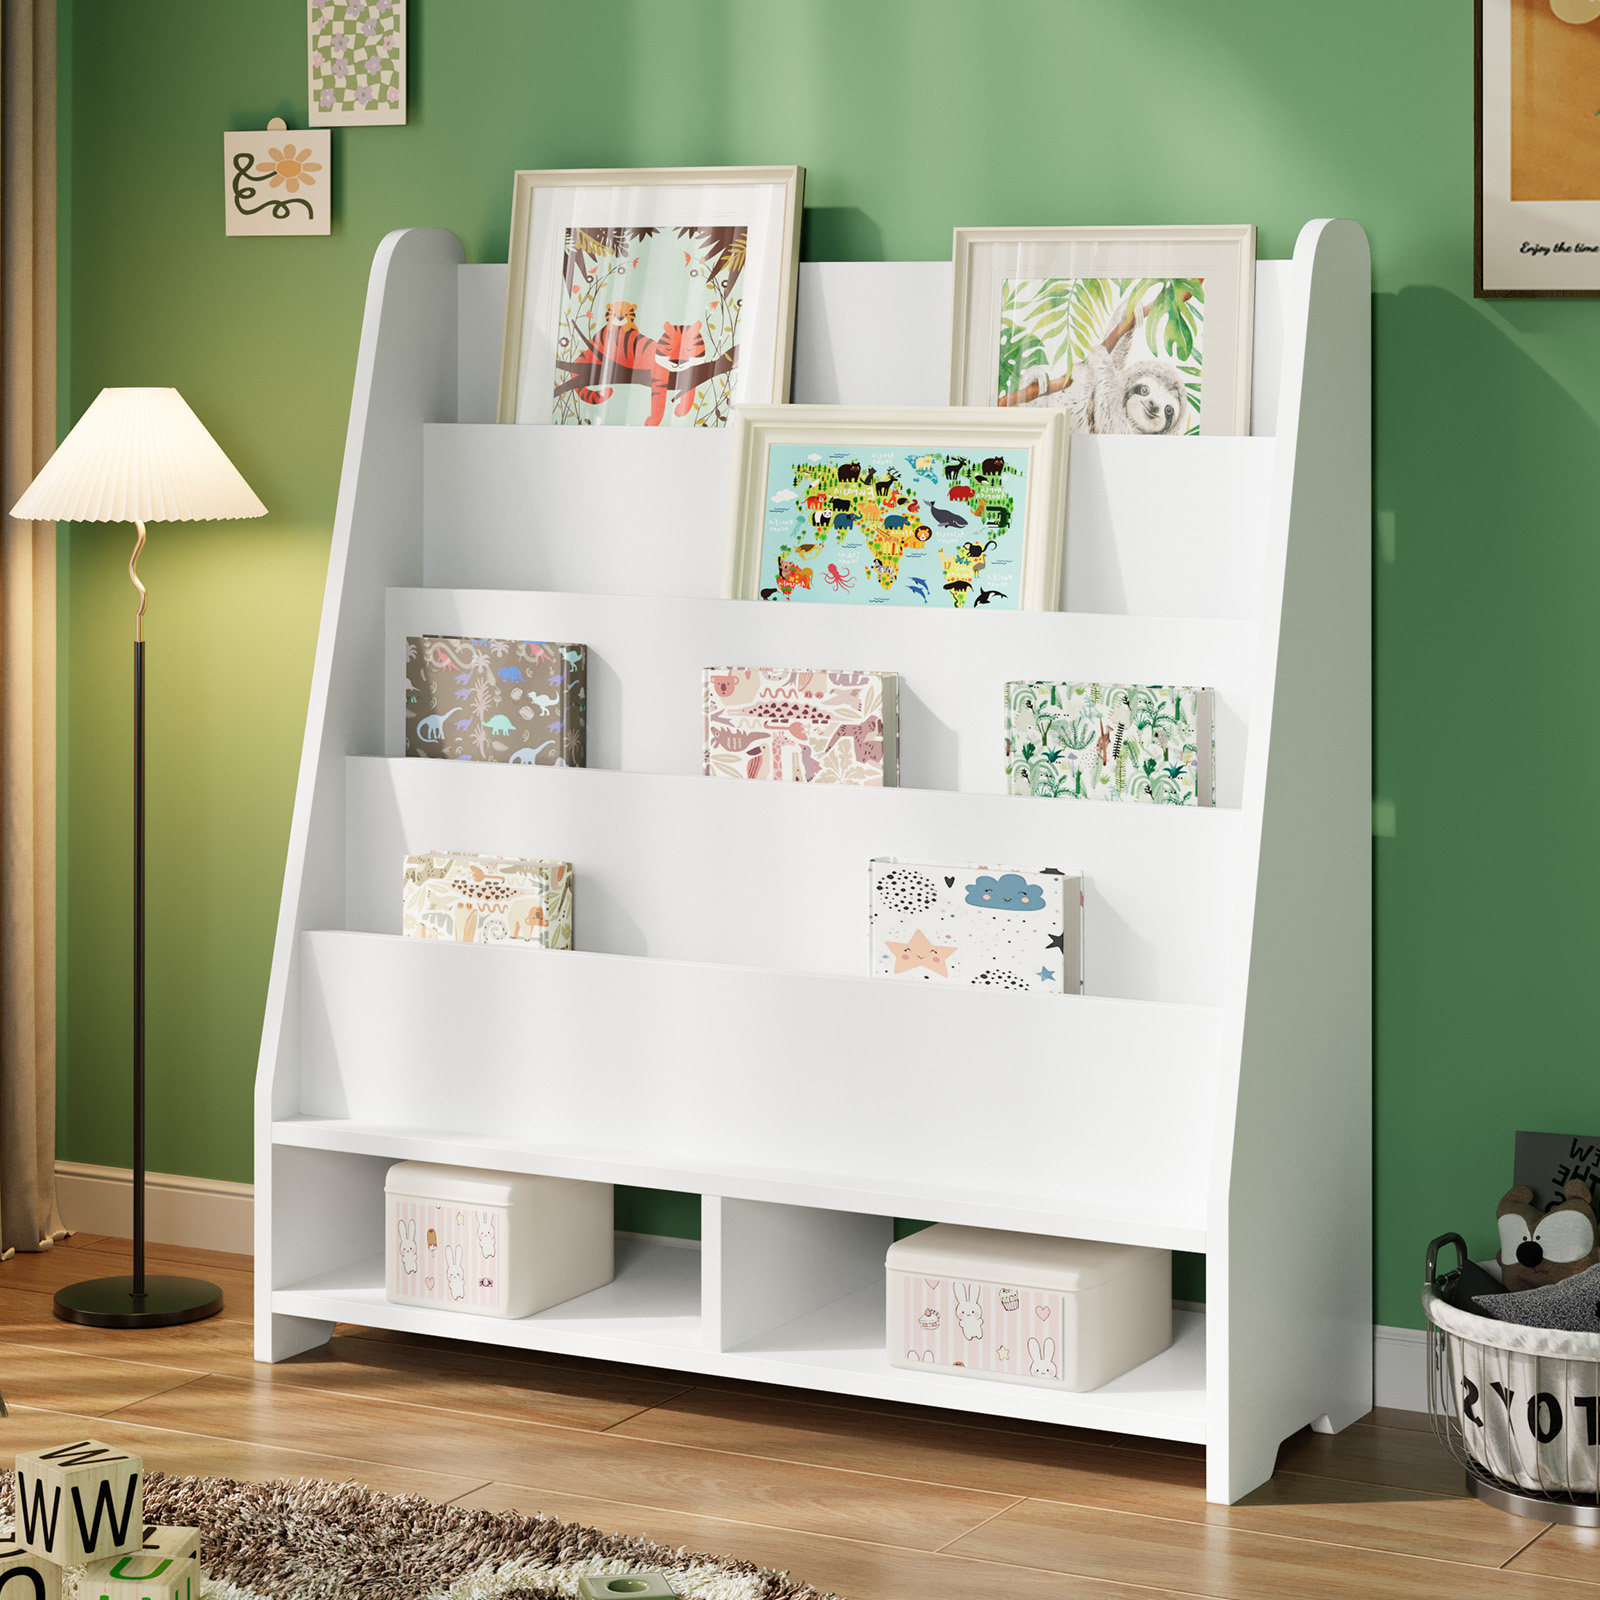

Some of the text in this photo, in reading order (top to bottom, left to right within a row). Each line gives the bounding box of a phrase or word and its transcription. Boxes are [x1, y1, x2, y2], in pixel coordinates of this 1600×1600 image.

[1519, 240, 1600, 256] Enjoy the time
[18, 1471, 61, 1553] W
[71, 1473, 138, 1554] W
